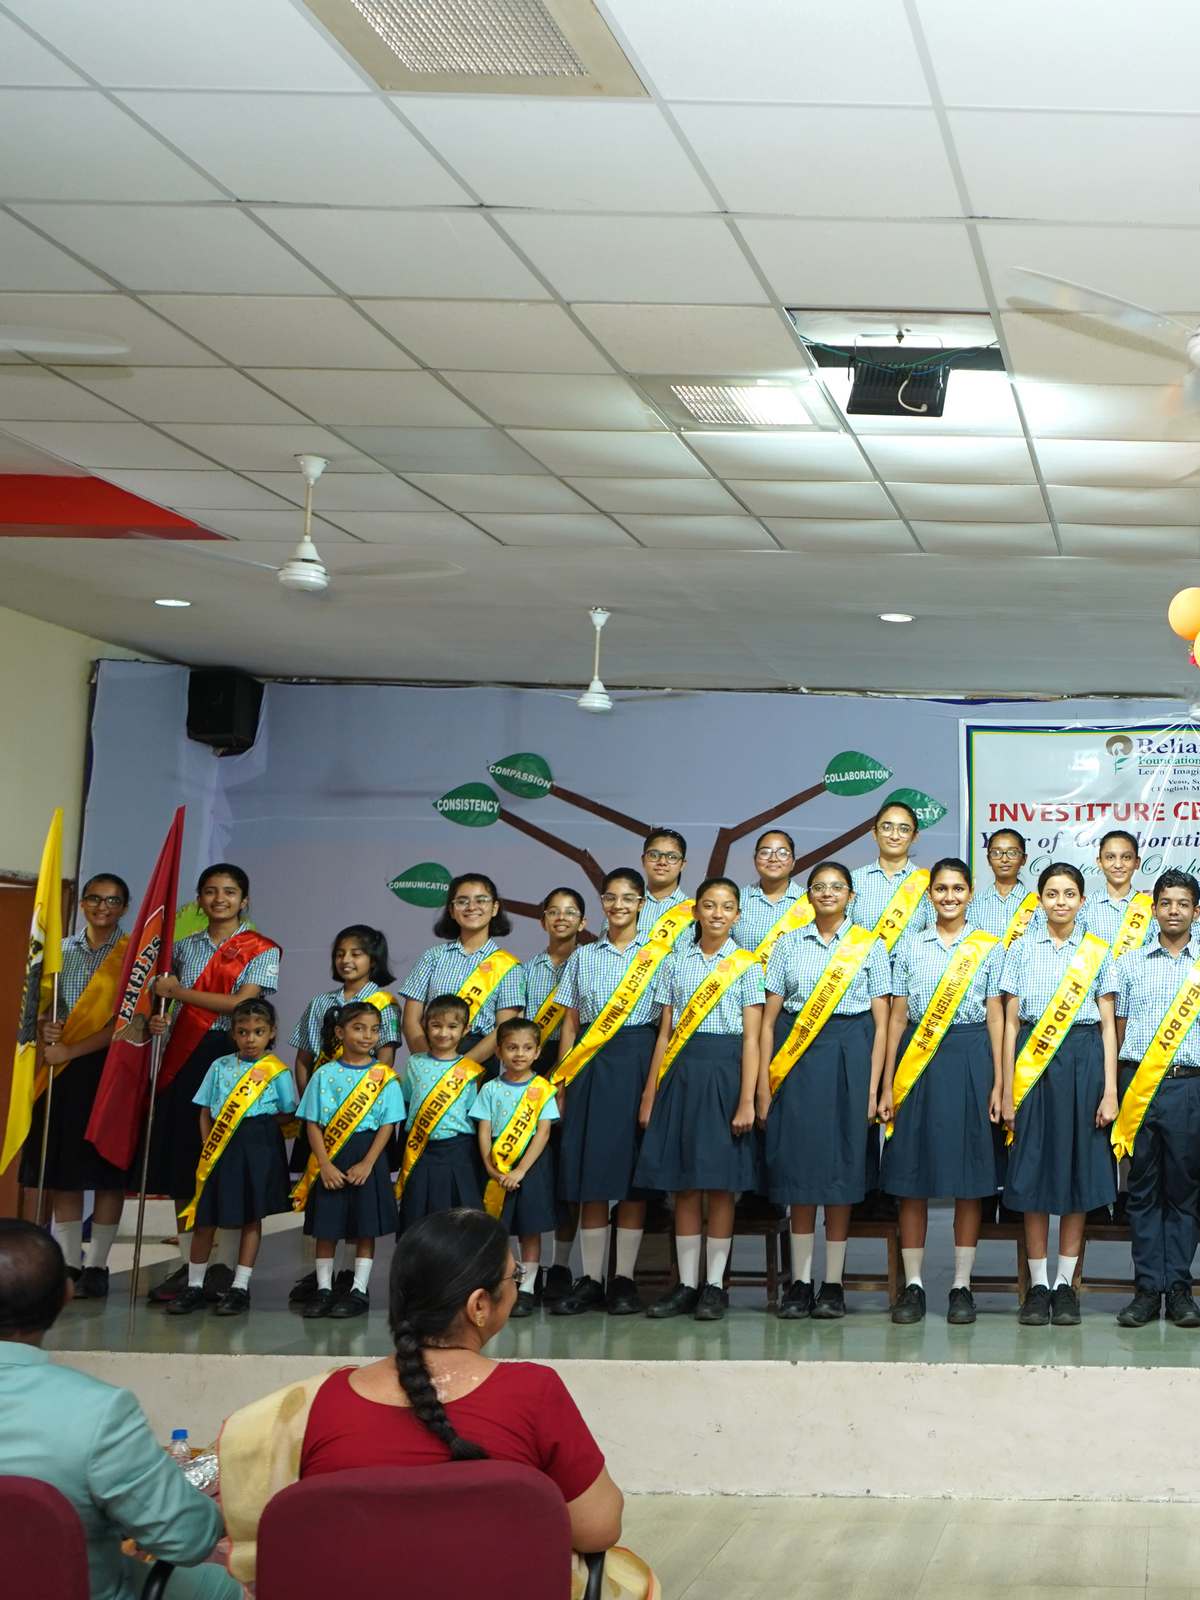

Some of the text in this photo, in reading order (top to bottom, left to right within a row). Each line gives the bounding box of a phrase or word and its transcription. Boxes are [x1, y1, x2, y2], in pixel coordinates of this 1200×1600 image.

[489, 764, 552, 788] COMPASSION
[824, 770, 889, 784] COLLABORATION
[1138, 768, 1165, 776] Lean
[437, 798, 500, 814] CONSISTENCY
[988, 802, 1166, 822] INVESTITURE
[1038, 831, 1063, 854] of
[388, 880, 449, 892] COMMUNICATIO
[119, 934, 160, 1025] EAGLES
[625, 955, 652, 993] PREFECT
[808, 981, 836, 1019] VOLUNTEER
[1031, 981, 1082, 1059] HEAD GIRL
[1156, 1018, 1182, 1051] BOY
[200, 1100, 240, 1162] MEMBER
[406, 1089, 450, 1151] MEMBERS
[495, 1103, 535, 1161] PREFECT
